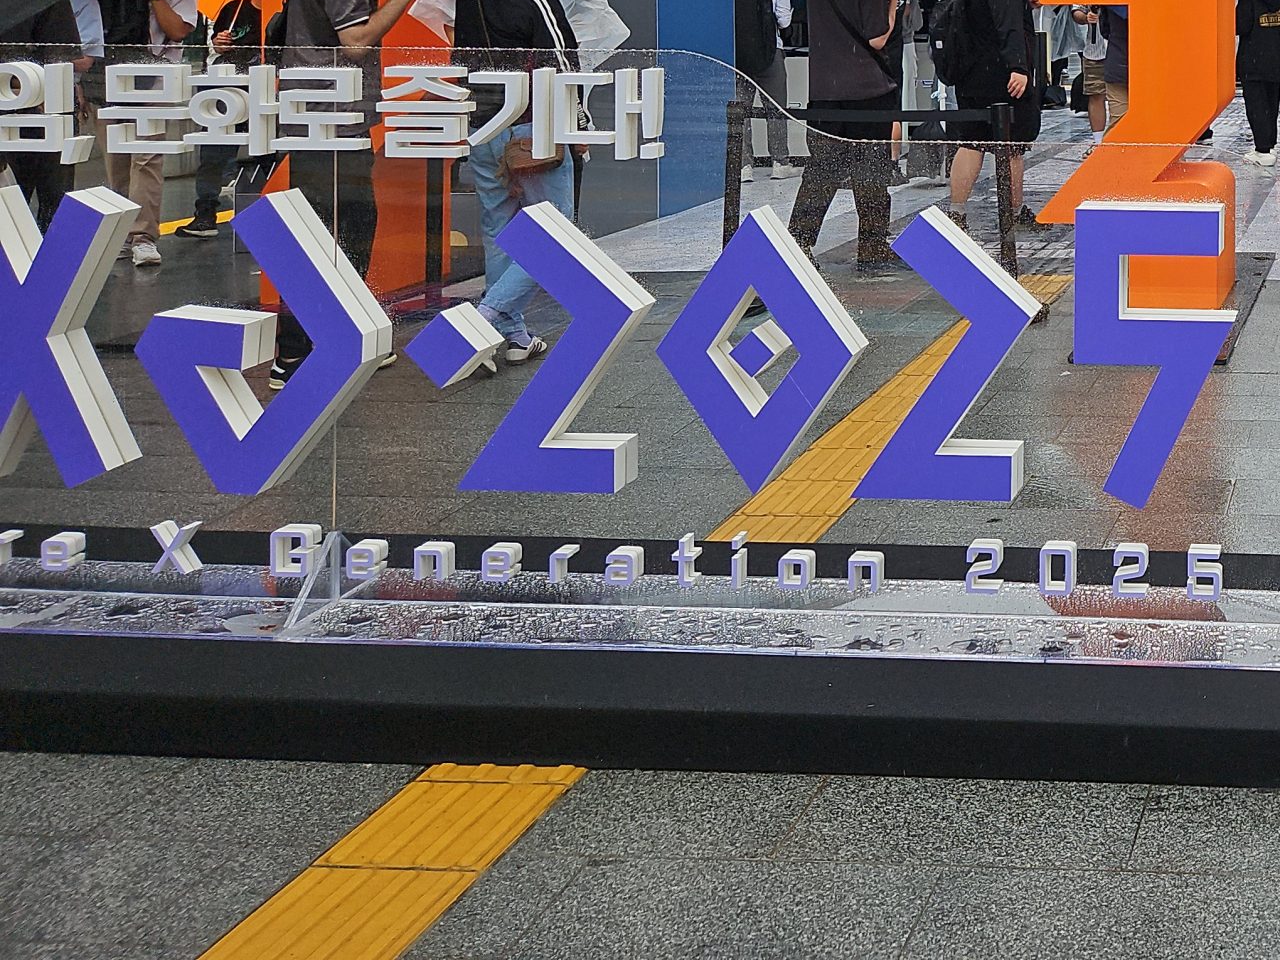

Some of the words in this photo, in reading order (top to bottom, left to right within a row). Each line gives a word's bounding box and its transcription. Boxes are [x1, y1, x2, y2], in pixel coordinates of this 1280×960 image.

[97, 63, 370, 156] 문화로
[151, 519, 203, 575] X
[270, 523, 885, 592] Generation
[965, 538, 1223, 602] 2025
